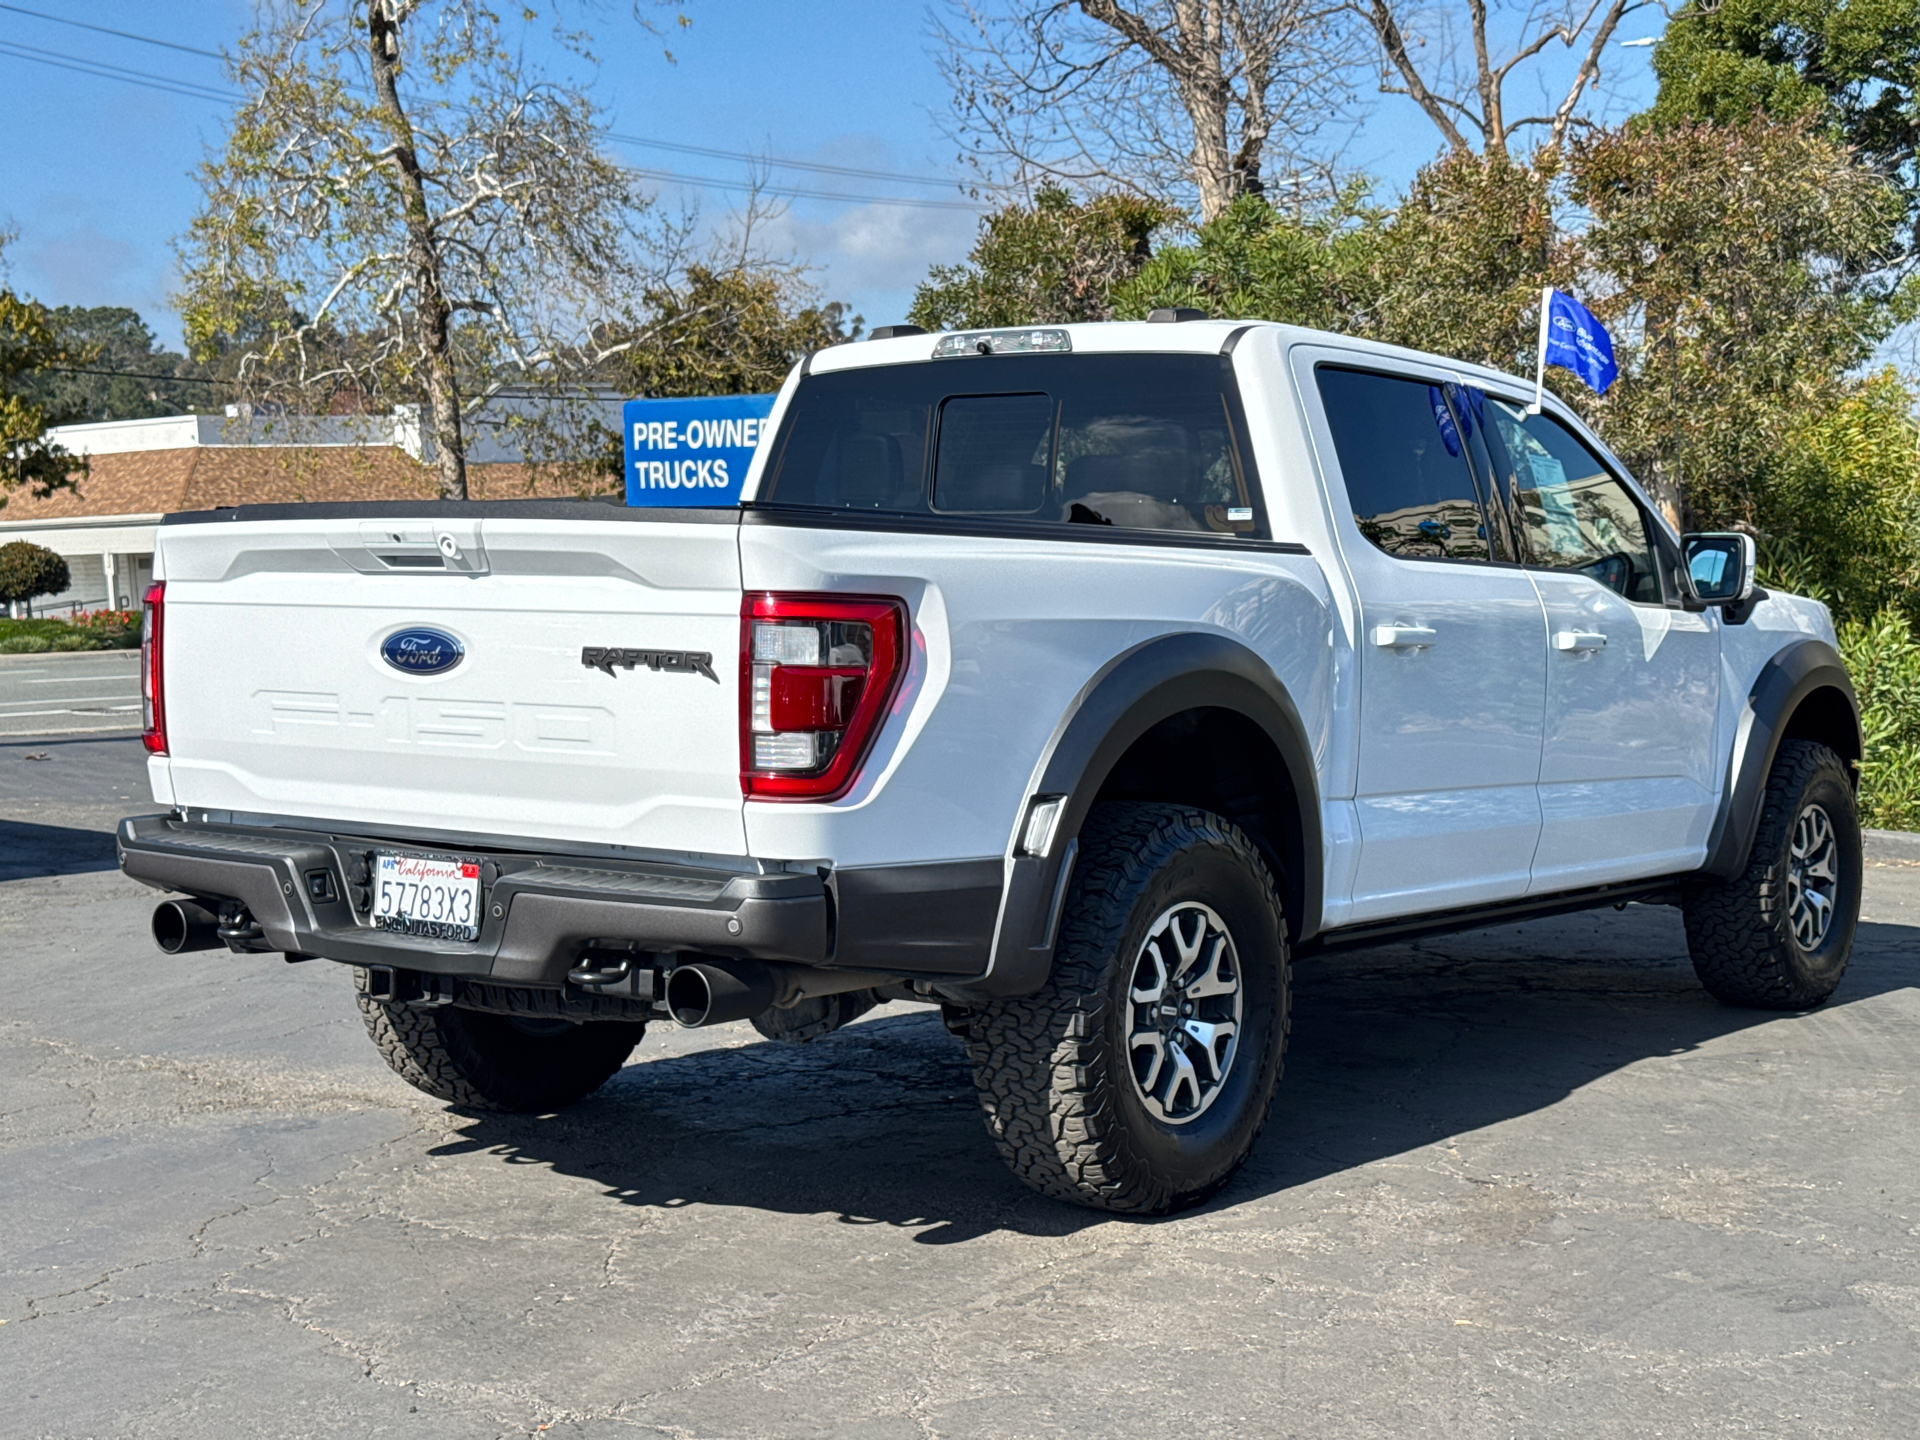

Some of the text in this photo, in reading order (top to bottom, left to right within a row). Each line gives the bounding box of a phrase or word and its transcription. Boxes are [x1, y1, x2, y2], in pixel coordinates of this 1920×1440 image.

[635, 459, 729, 489] TRUCKS
[396, 637, 442, 665] Ford
[582, 646, 721, 685] RAPTOR
[382, 859, 395, 870] APR
[398, 858, 462, 882] California
[381, 881, 472, 923] 57783X3
[439, 924, 472, 942] FORD
